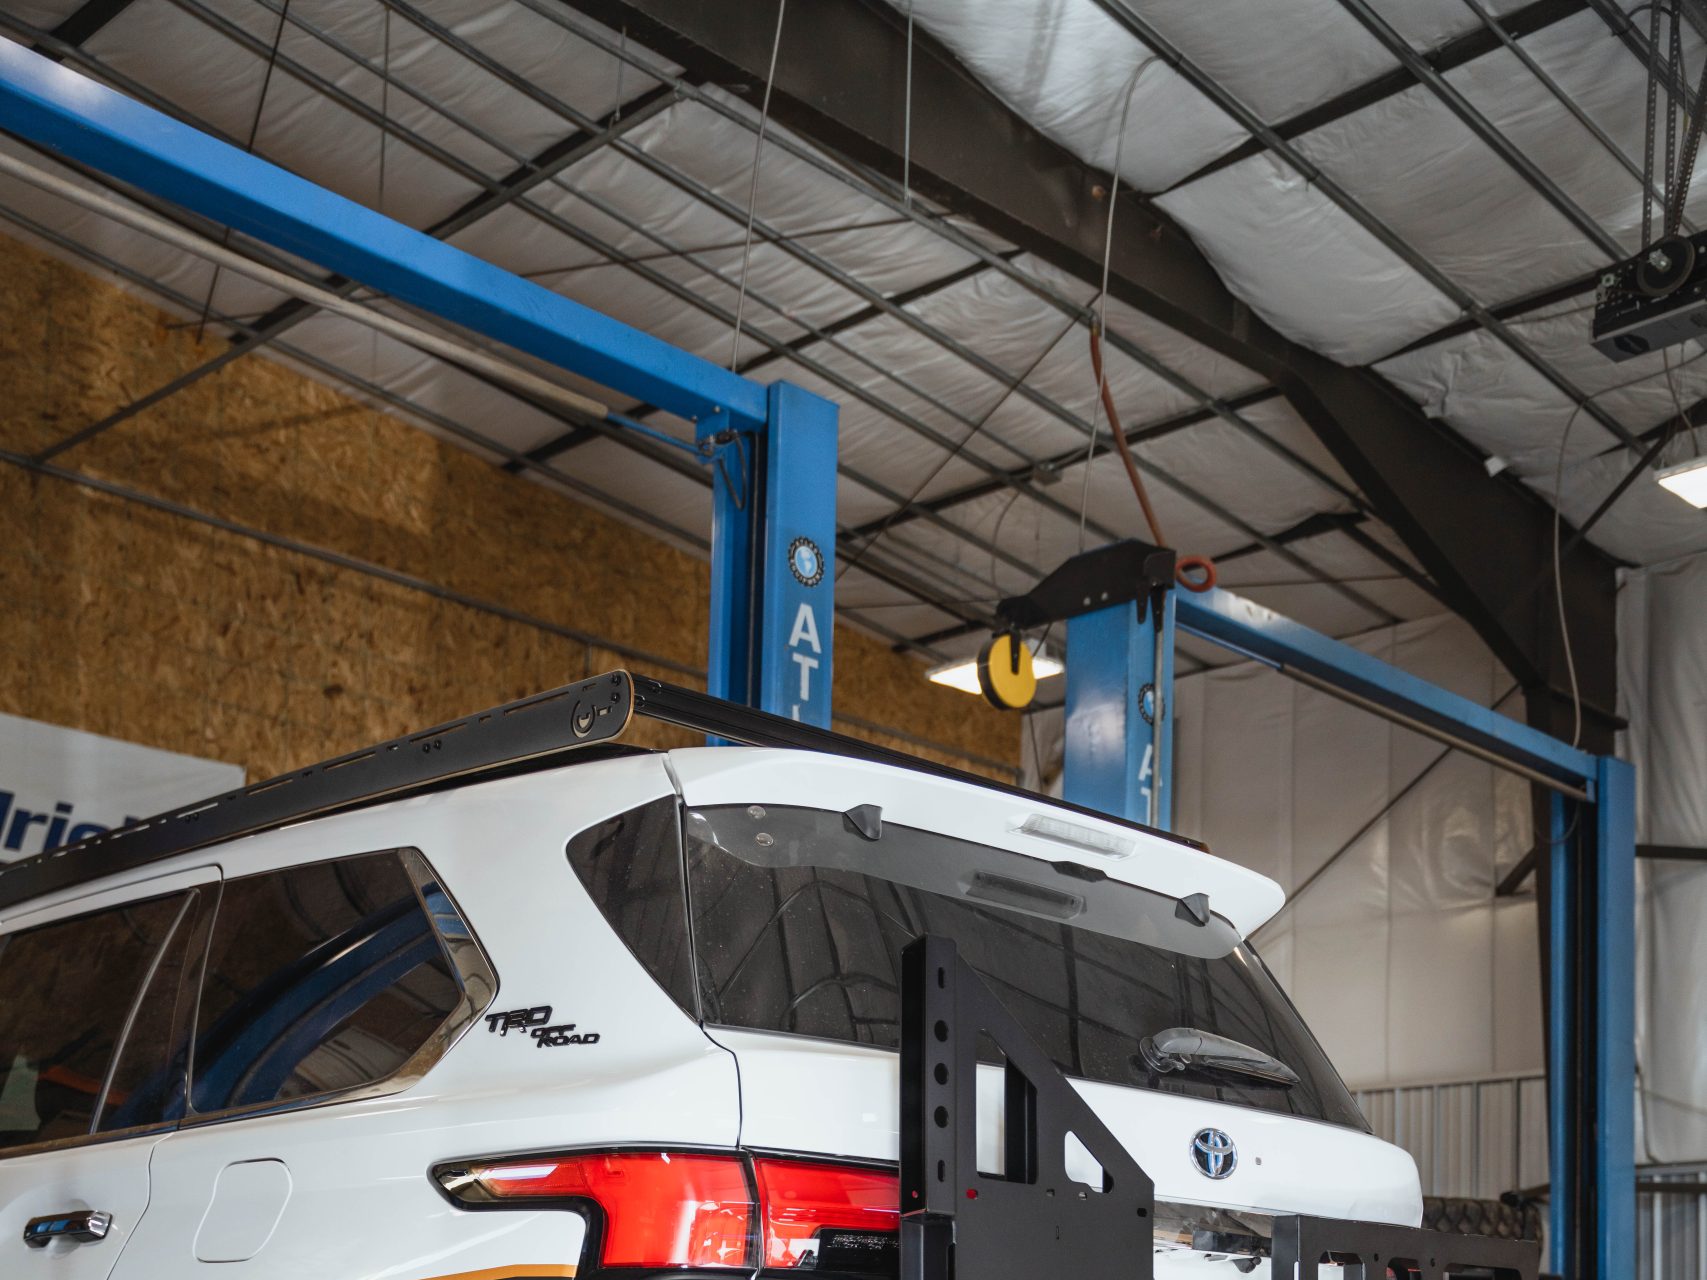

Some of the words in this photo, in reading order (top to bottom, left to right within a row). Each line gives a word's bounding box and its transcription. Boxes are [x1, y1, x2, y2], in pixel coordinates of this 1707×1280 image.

[485, 1005, 553, 1037] TRD
[530, 1023, 577, 1039] OFF
[536, 1033, 600, 1049] ROAD
